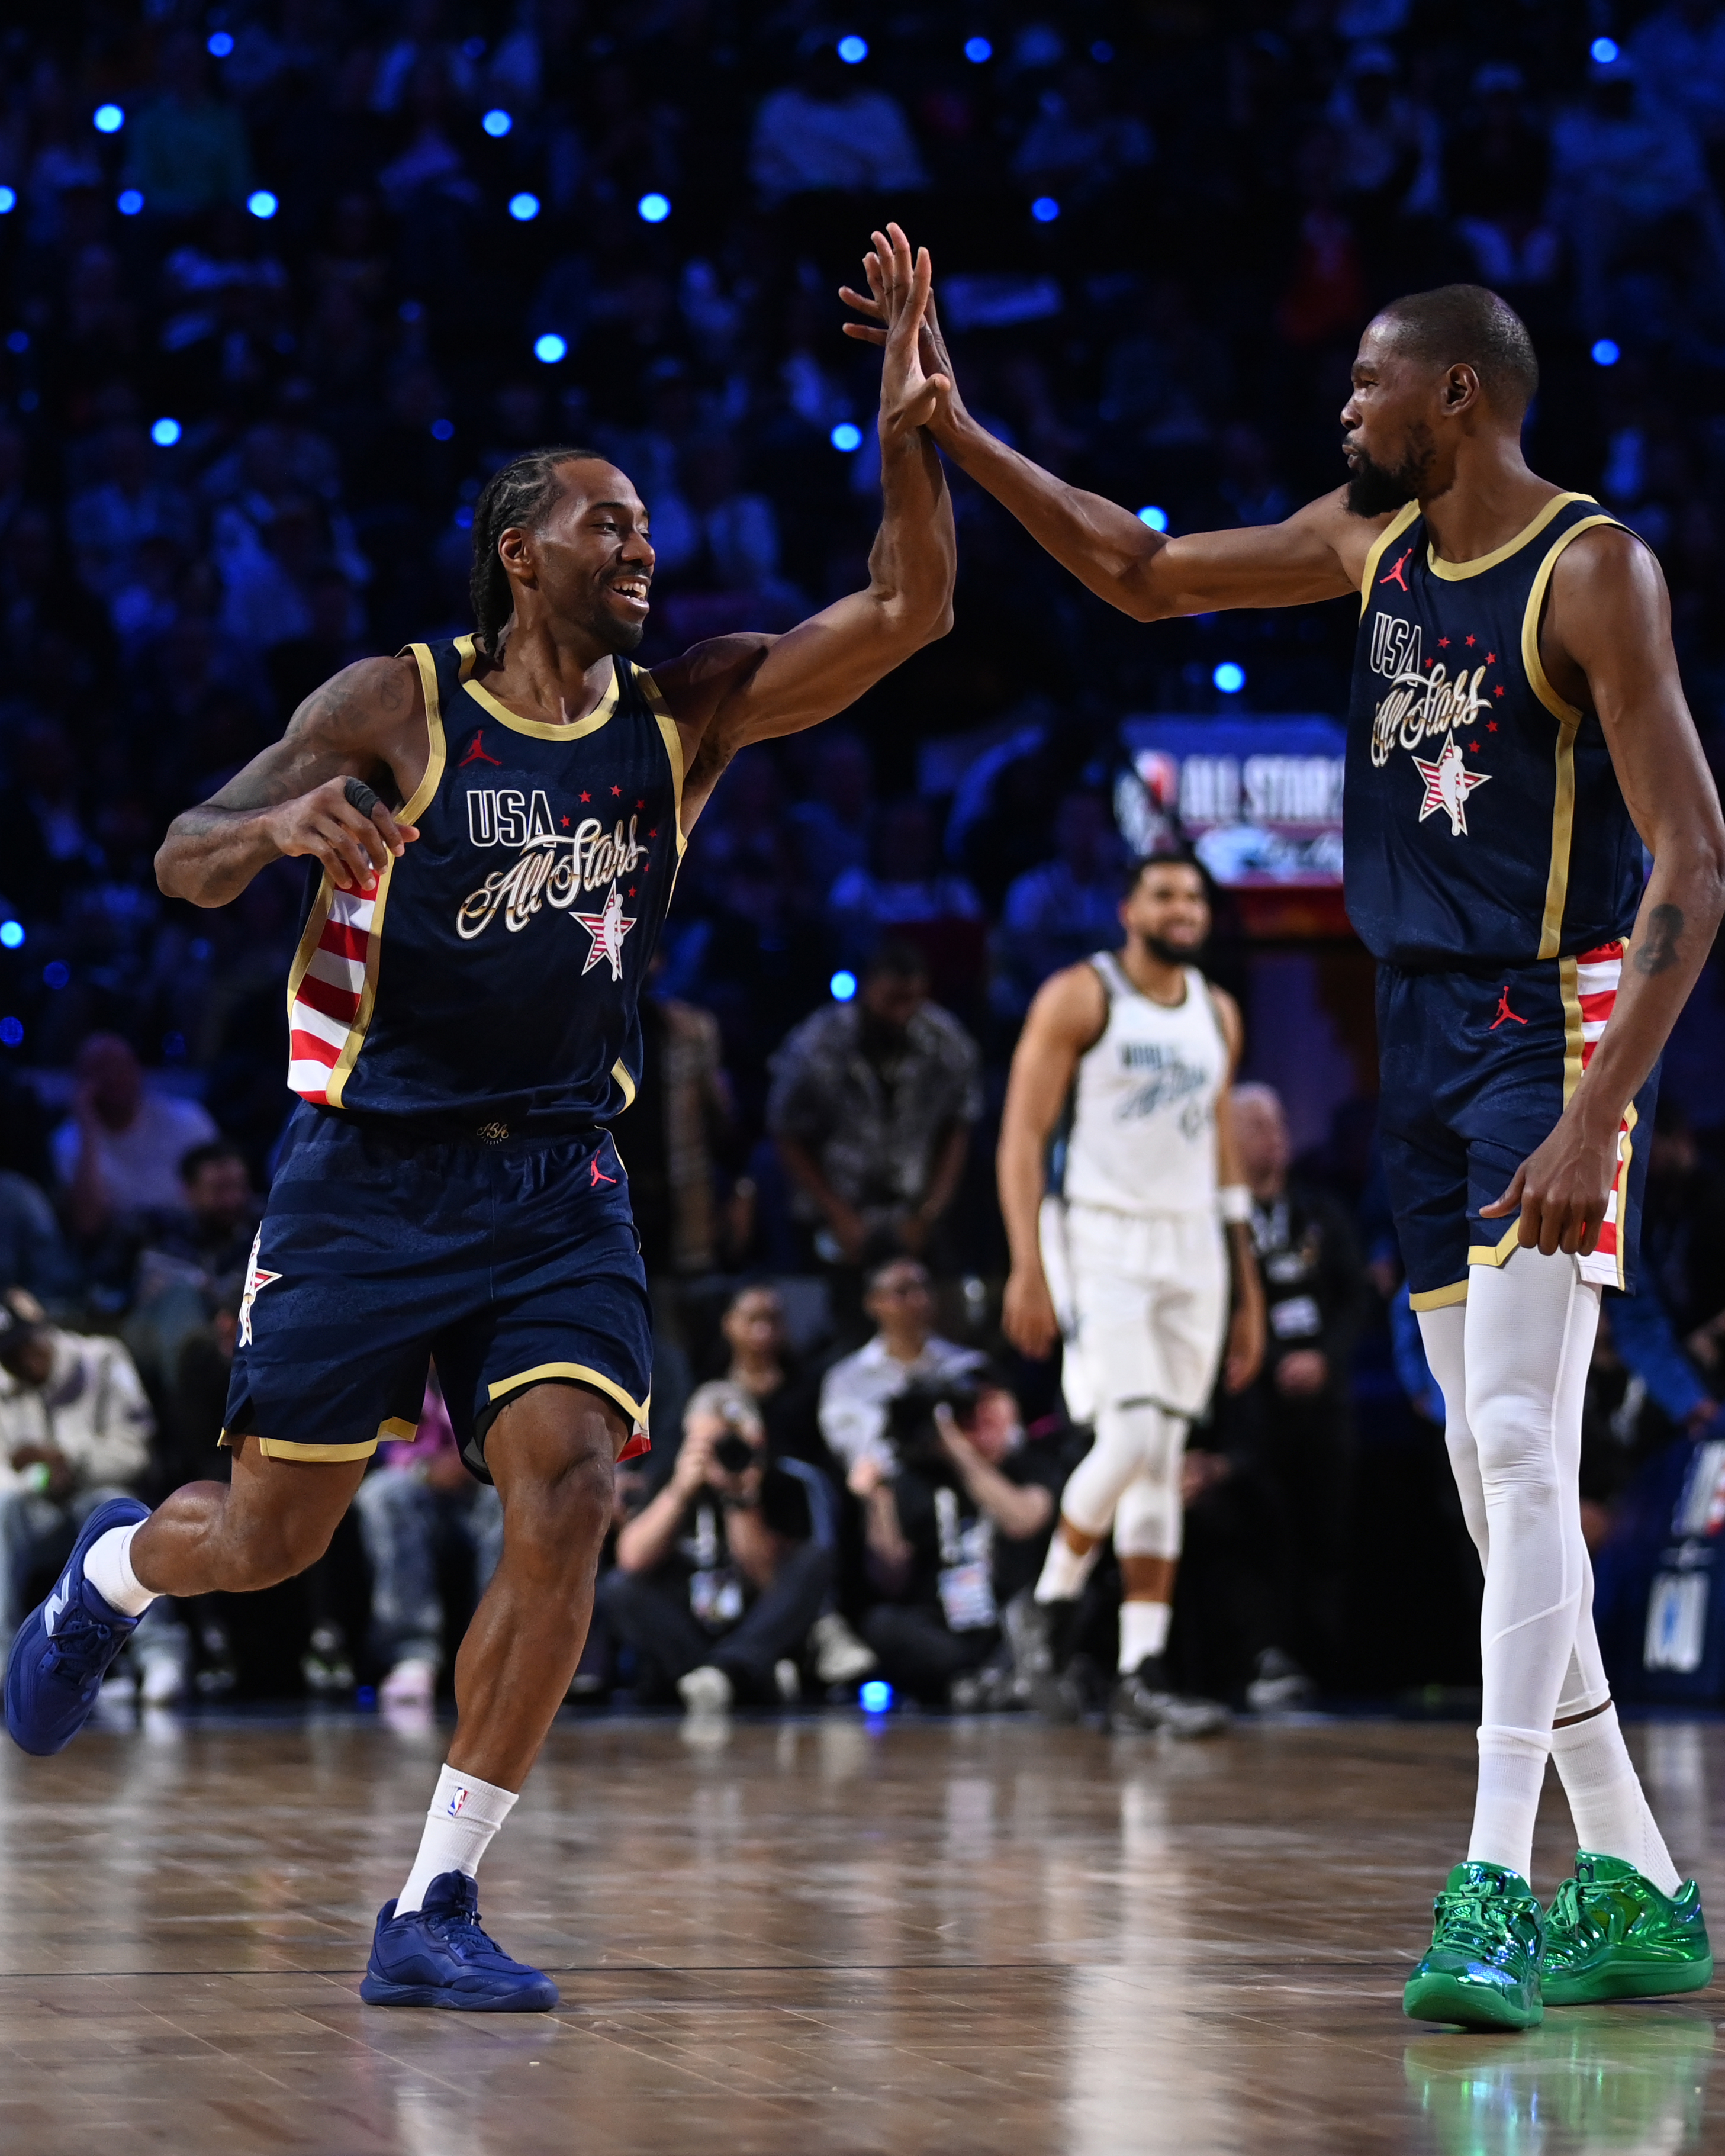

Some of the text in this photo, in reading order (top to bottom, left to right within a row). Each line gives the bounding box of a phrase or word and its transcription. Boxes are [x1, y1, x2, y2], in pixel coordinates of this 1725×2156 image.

[1370, 611, 1421, 687] USA
[1370, 662, 1493, 768] All Stars
[466, 789, 558, 848] USA
[455, 814, 649, 941] All Stars
